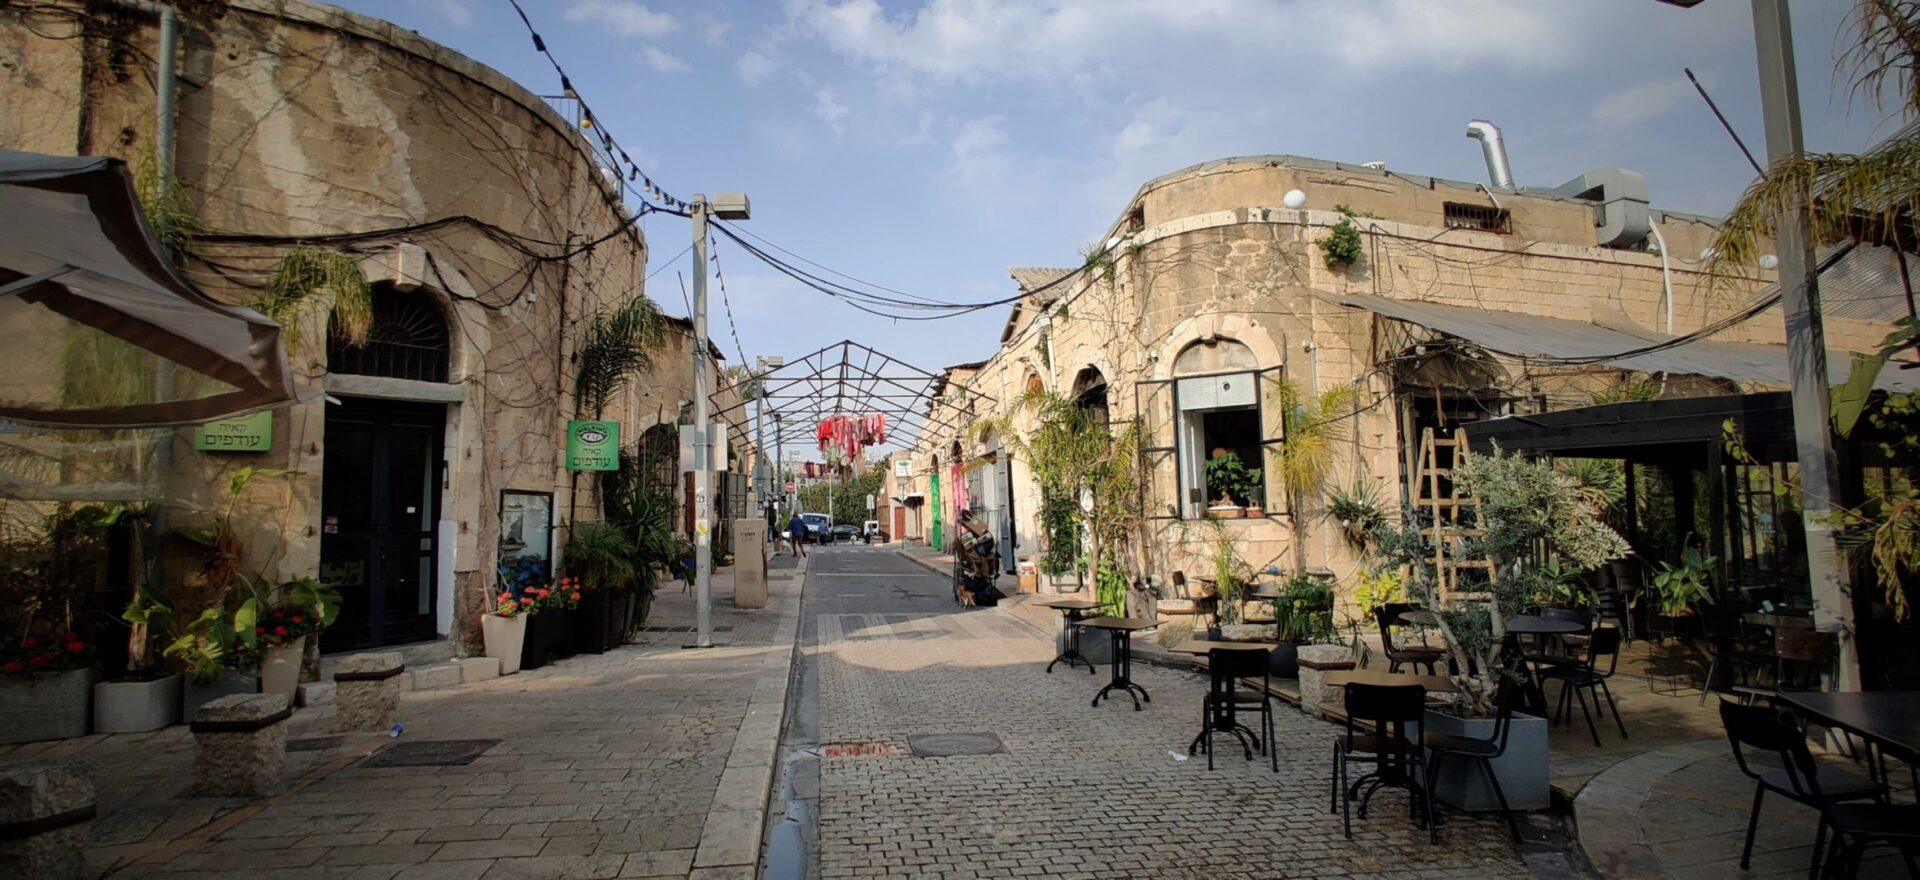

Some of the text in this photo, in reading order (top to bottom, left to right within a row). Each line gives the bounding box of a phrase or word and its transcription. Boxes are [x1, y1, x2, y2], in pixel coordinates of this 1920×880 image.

[219, 423, 247, 432] קאיה
[205, 434, 261, 447] עודפים
[573, 457, 611, 468] עודפים
